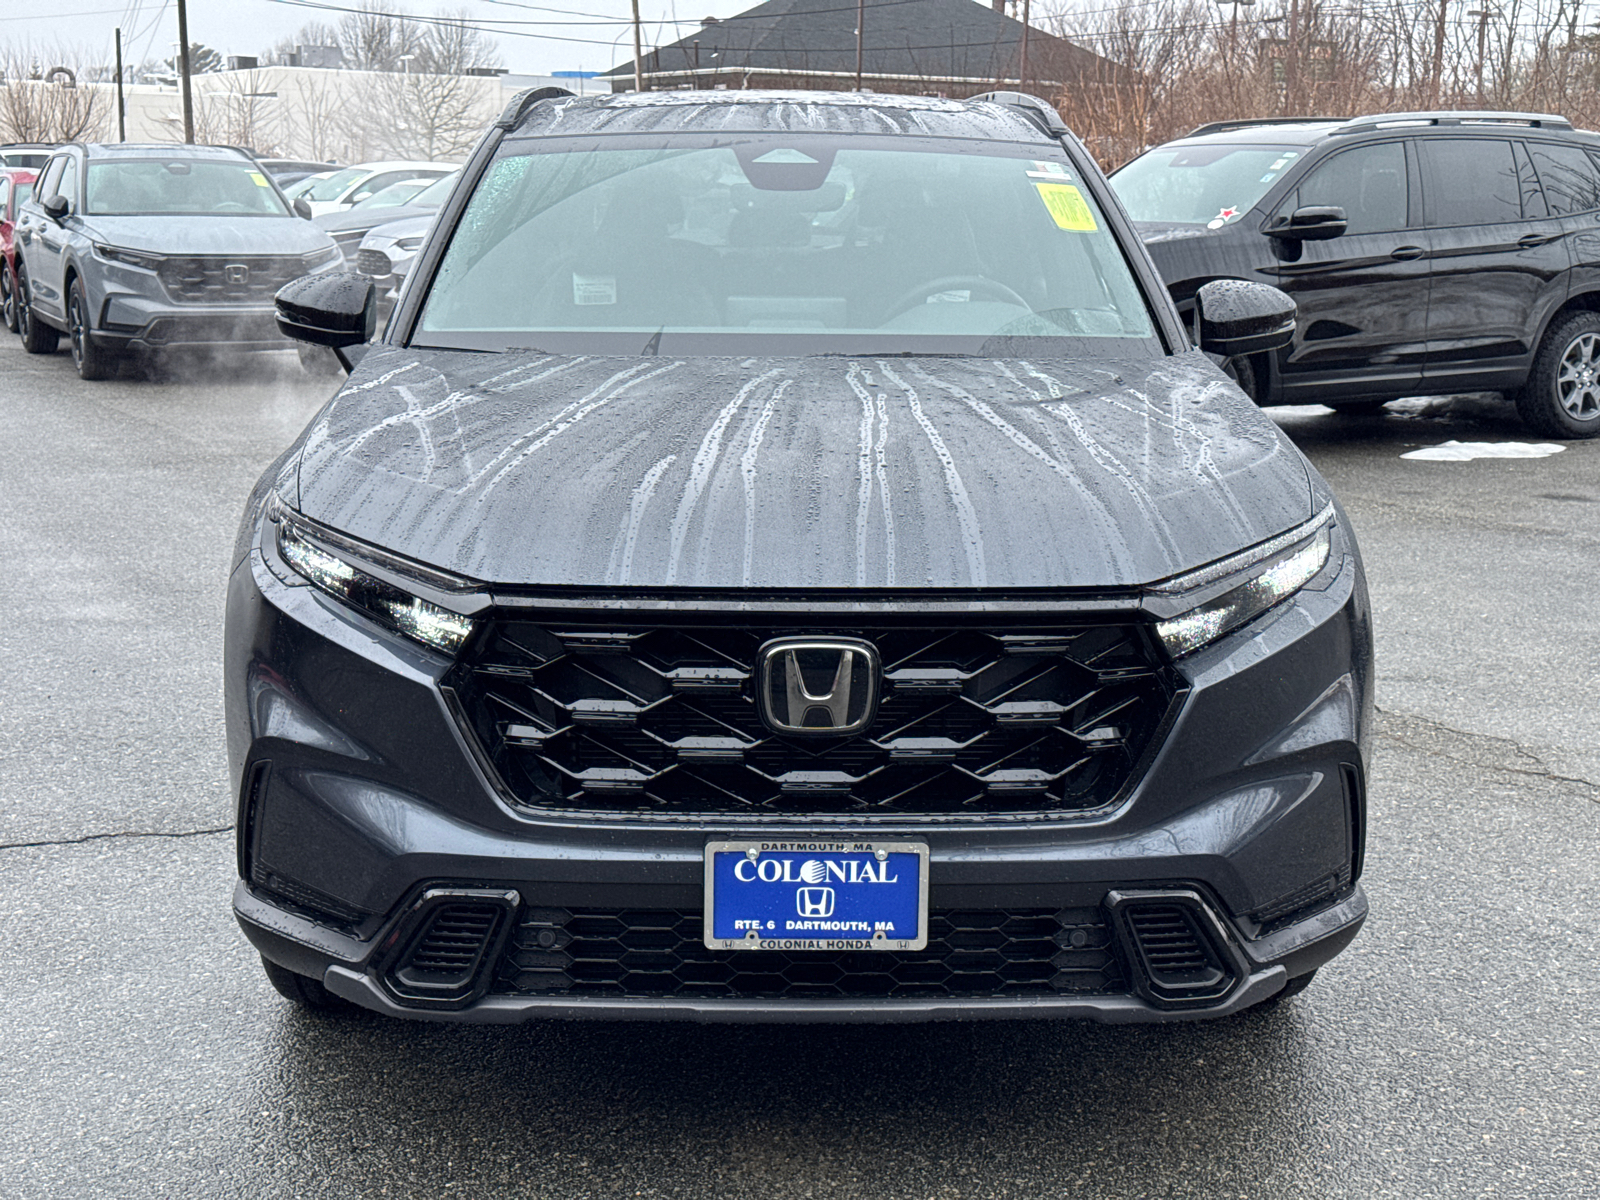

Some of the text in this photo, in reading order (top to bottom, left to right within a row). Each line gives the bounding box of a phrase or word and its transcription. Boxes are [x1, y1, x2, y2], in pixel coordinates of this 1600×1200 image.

[853, 843, 873, 851] MA
[734, 859, 898, 884] COLONIAL
[734, 920, 895, 932] RTE. 6 DARTMOUTH, MA
[759, 940, 872, 949] COLONIAL HONDA
